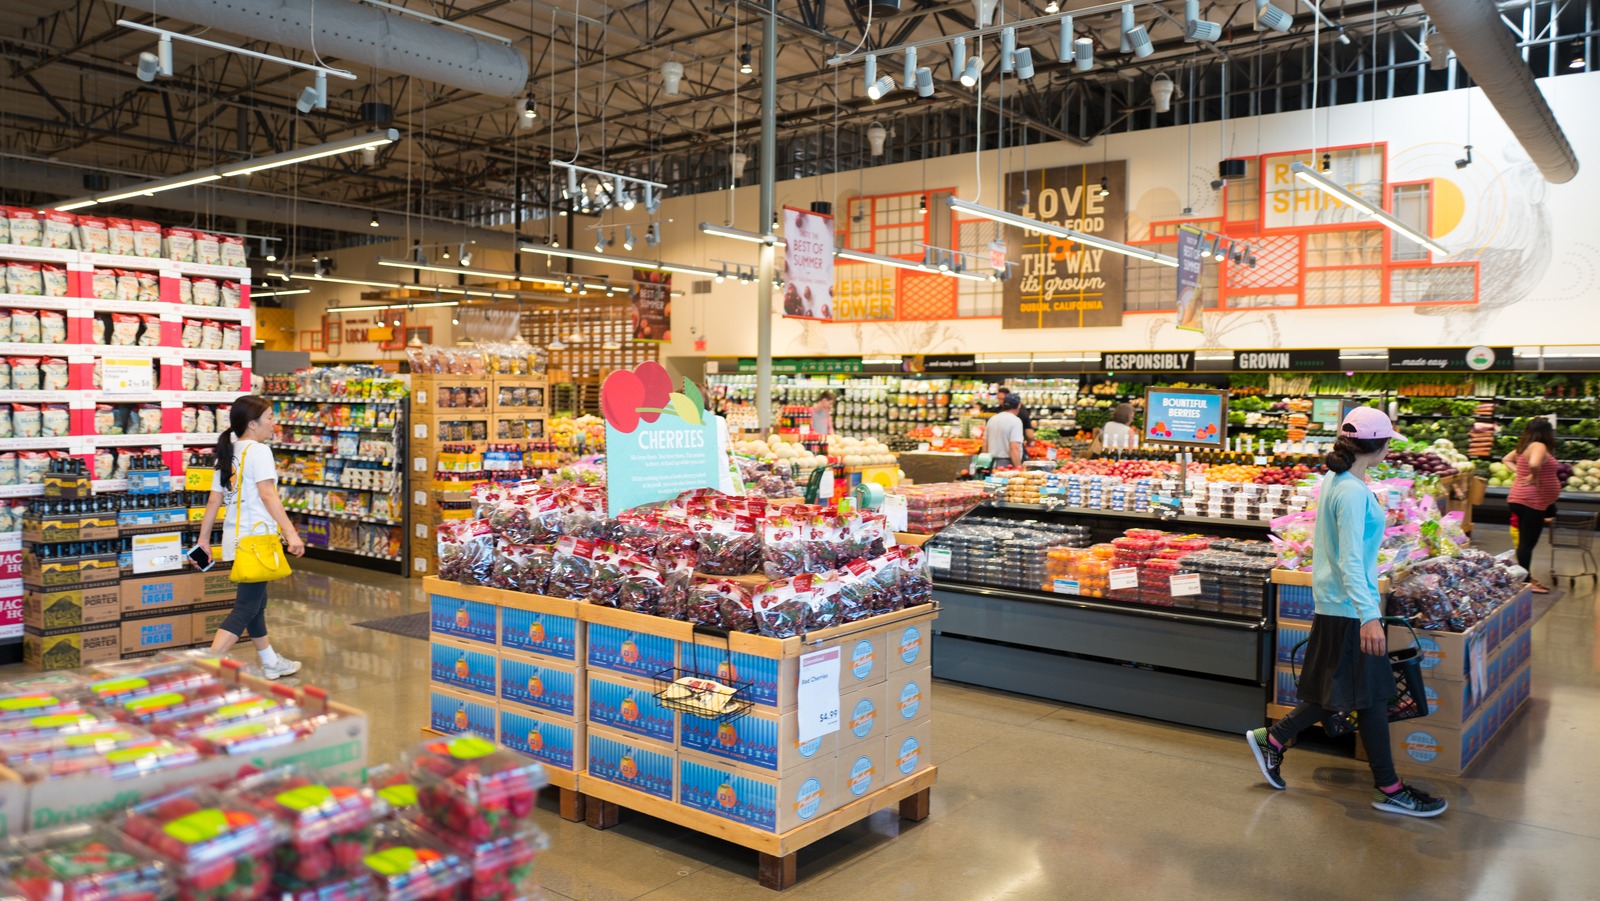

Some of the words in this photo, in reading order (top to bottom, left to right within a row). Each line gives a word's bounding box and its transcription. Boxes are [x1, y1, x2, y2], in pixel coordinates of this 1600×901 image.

[1022, 184, 1105, 219] LOVE
[1064, 217, 1105, 233] FOOD
[793, 239, 811, 253] BEST
[812, 242, 823, 255] OF
[793, 254, 823, 269] SUMMER
[1021, 253, 1056, 276] THE
[1065, 249, 1104, 274] WAY
[1044, 276, 1106, 300] grown
[1053, 300, 1104, 311] CALIFORNIA
[1105, 353, 1189, 370] RESPONSIBLY
[1239, 352, 1291, 369] GROWN
[1426, 358, 1449, 369] easy
[1162, 397, 1208, 410] BOUNTIFUL
[1168, 408, 1201, 419] BERRIES
[638, 429, 705, 450] CHERRIES
[84, 597, 118, 607] PORTER
[141, 593, 173, 604] LAGER
[83, 639, 118, 649] PORTER
[141, 634, 173, 646] LAGER
[623, 649, 635, 659] DL
[811, 674, 829, 683] Cherries
[623, 707, 635, 717] DL
[819, 709, 838, 722] $4.99
[720, 731, 734, 742] DL
[719, 792, 733, 803] DL
